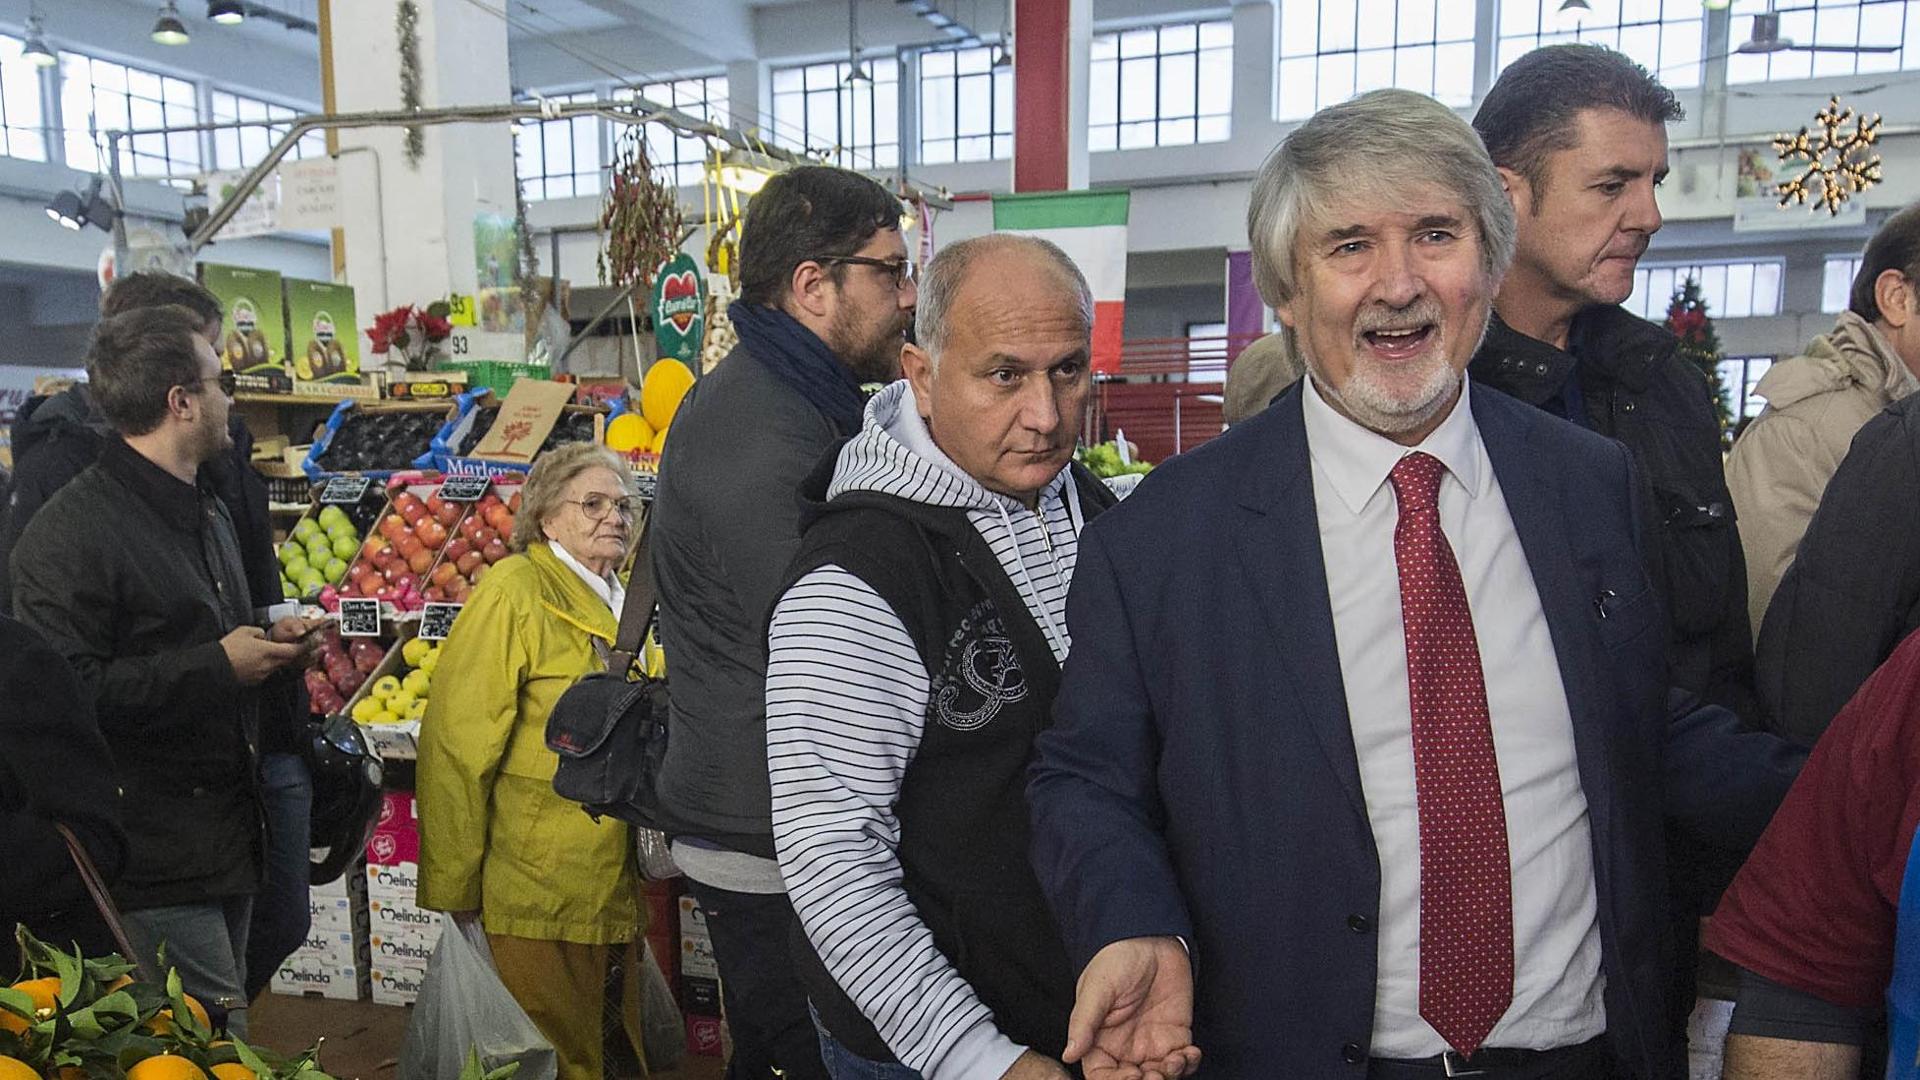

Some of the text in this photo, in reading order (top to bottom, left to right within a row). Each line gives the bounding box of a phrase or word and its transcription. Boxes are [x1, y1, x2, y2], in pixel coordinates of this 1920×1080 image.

[452, 335, 468, 354] 93
[380, 907, 431, 924] Melinda
[280, 967, 331, 984] Melinda
